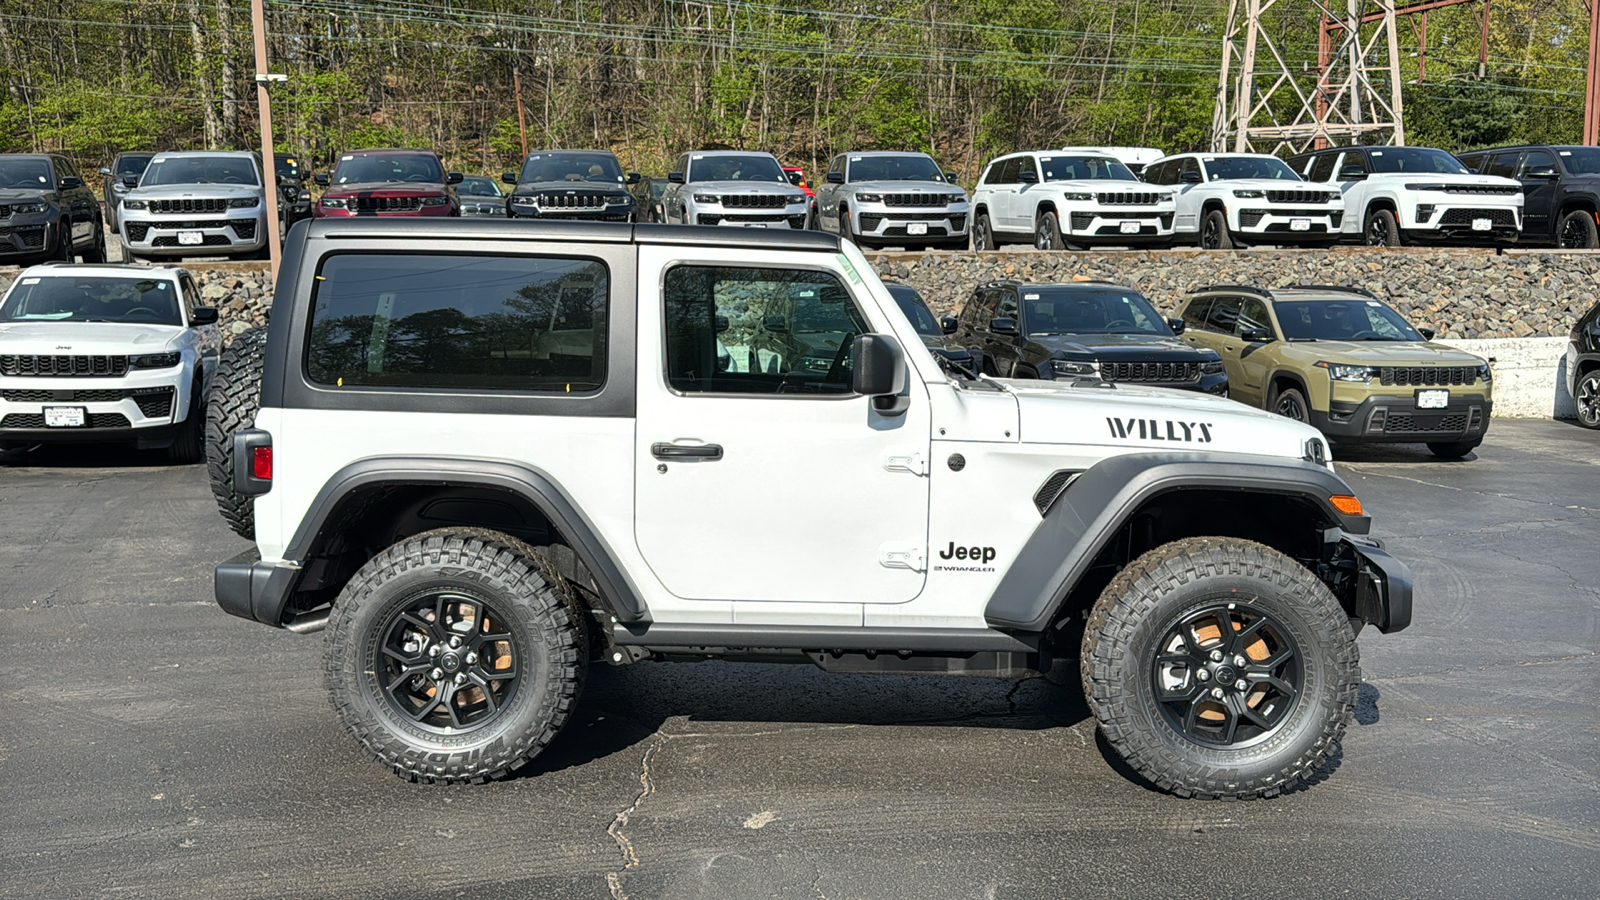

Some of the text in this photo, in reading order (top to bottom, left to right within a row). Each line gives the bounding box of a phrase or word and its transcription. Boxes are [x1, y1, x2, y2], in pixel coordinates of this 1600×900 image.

[1105, 416, 1213, 443] WILLYS
[938, 541, 997, 565] Jeep
[365, 709, 506, 764] WILDPEAK
[1121, 671, 1239, 779] WILDPEAK
